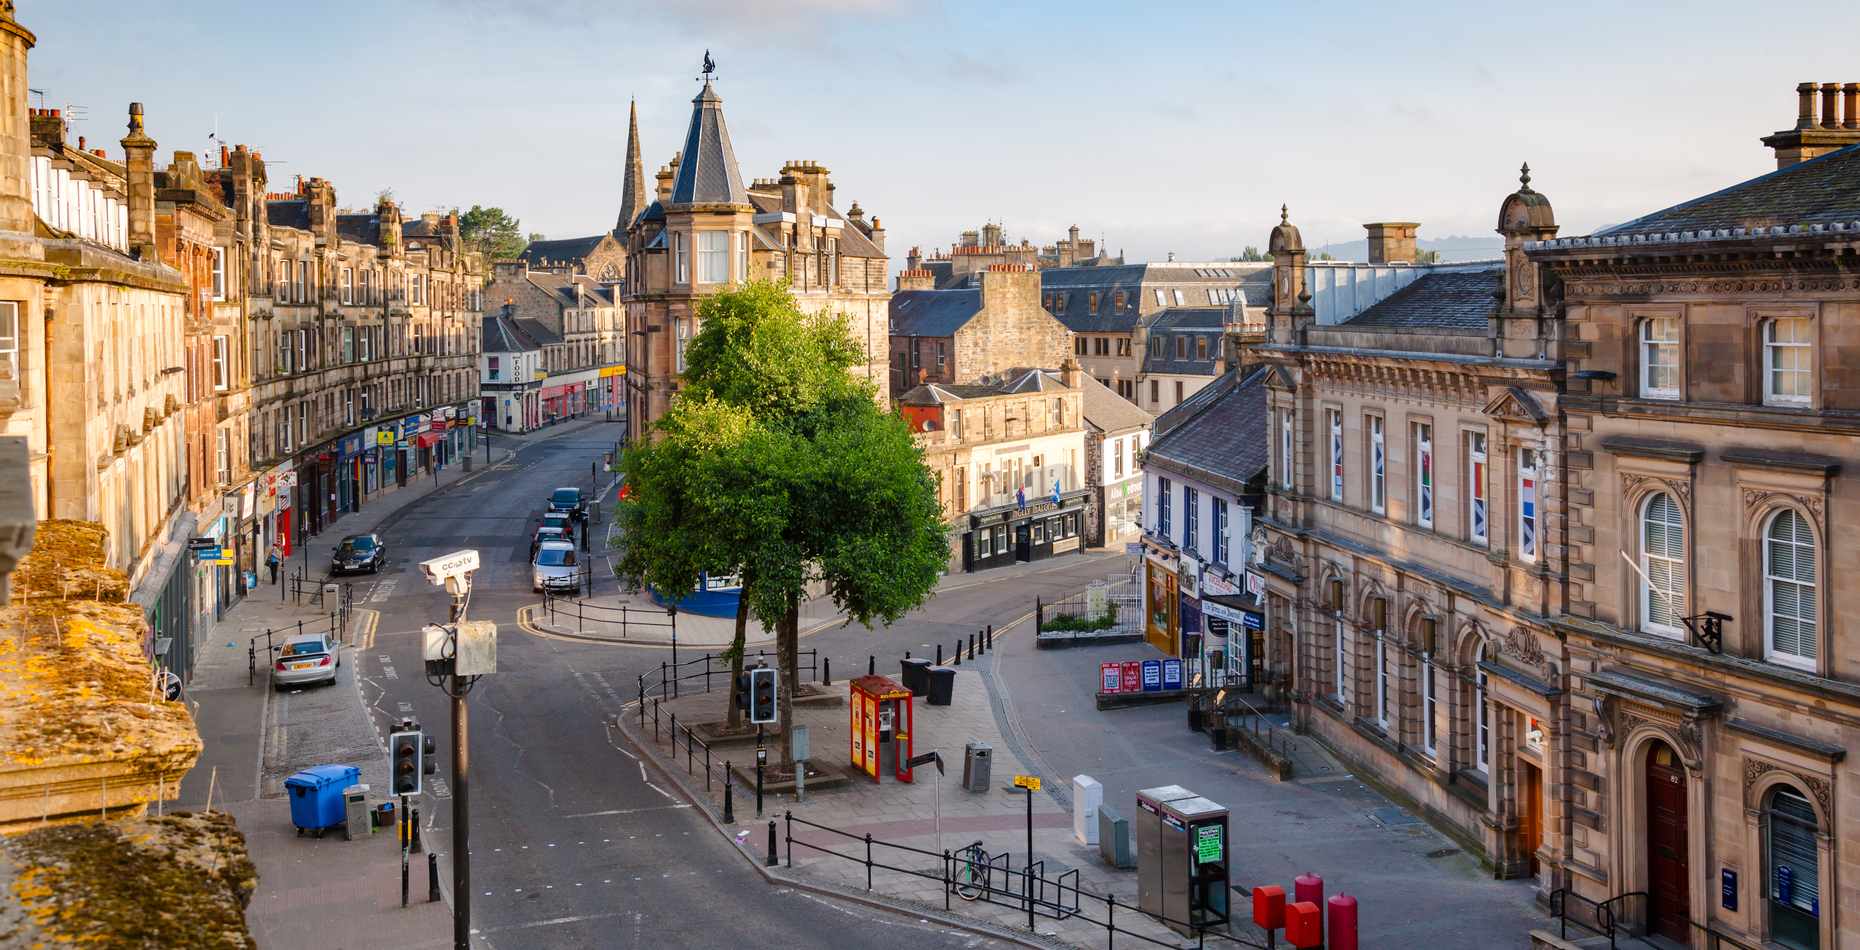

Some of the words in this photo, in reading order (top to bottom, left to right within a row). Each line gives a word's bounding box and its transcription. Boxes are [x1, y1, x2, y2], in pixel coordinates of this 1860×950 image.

[1367, 565, 1383, 579] POST
[1412, 582, 1432, 598] OFFICE
[1670, 774, 1679, 784] 82
[1141, 801, 1155, 813] Telephone
[1166, 814, 1182, 826] Telephone
